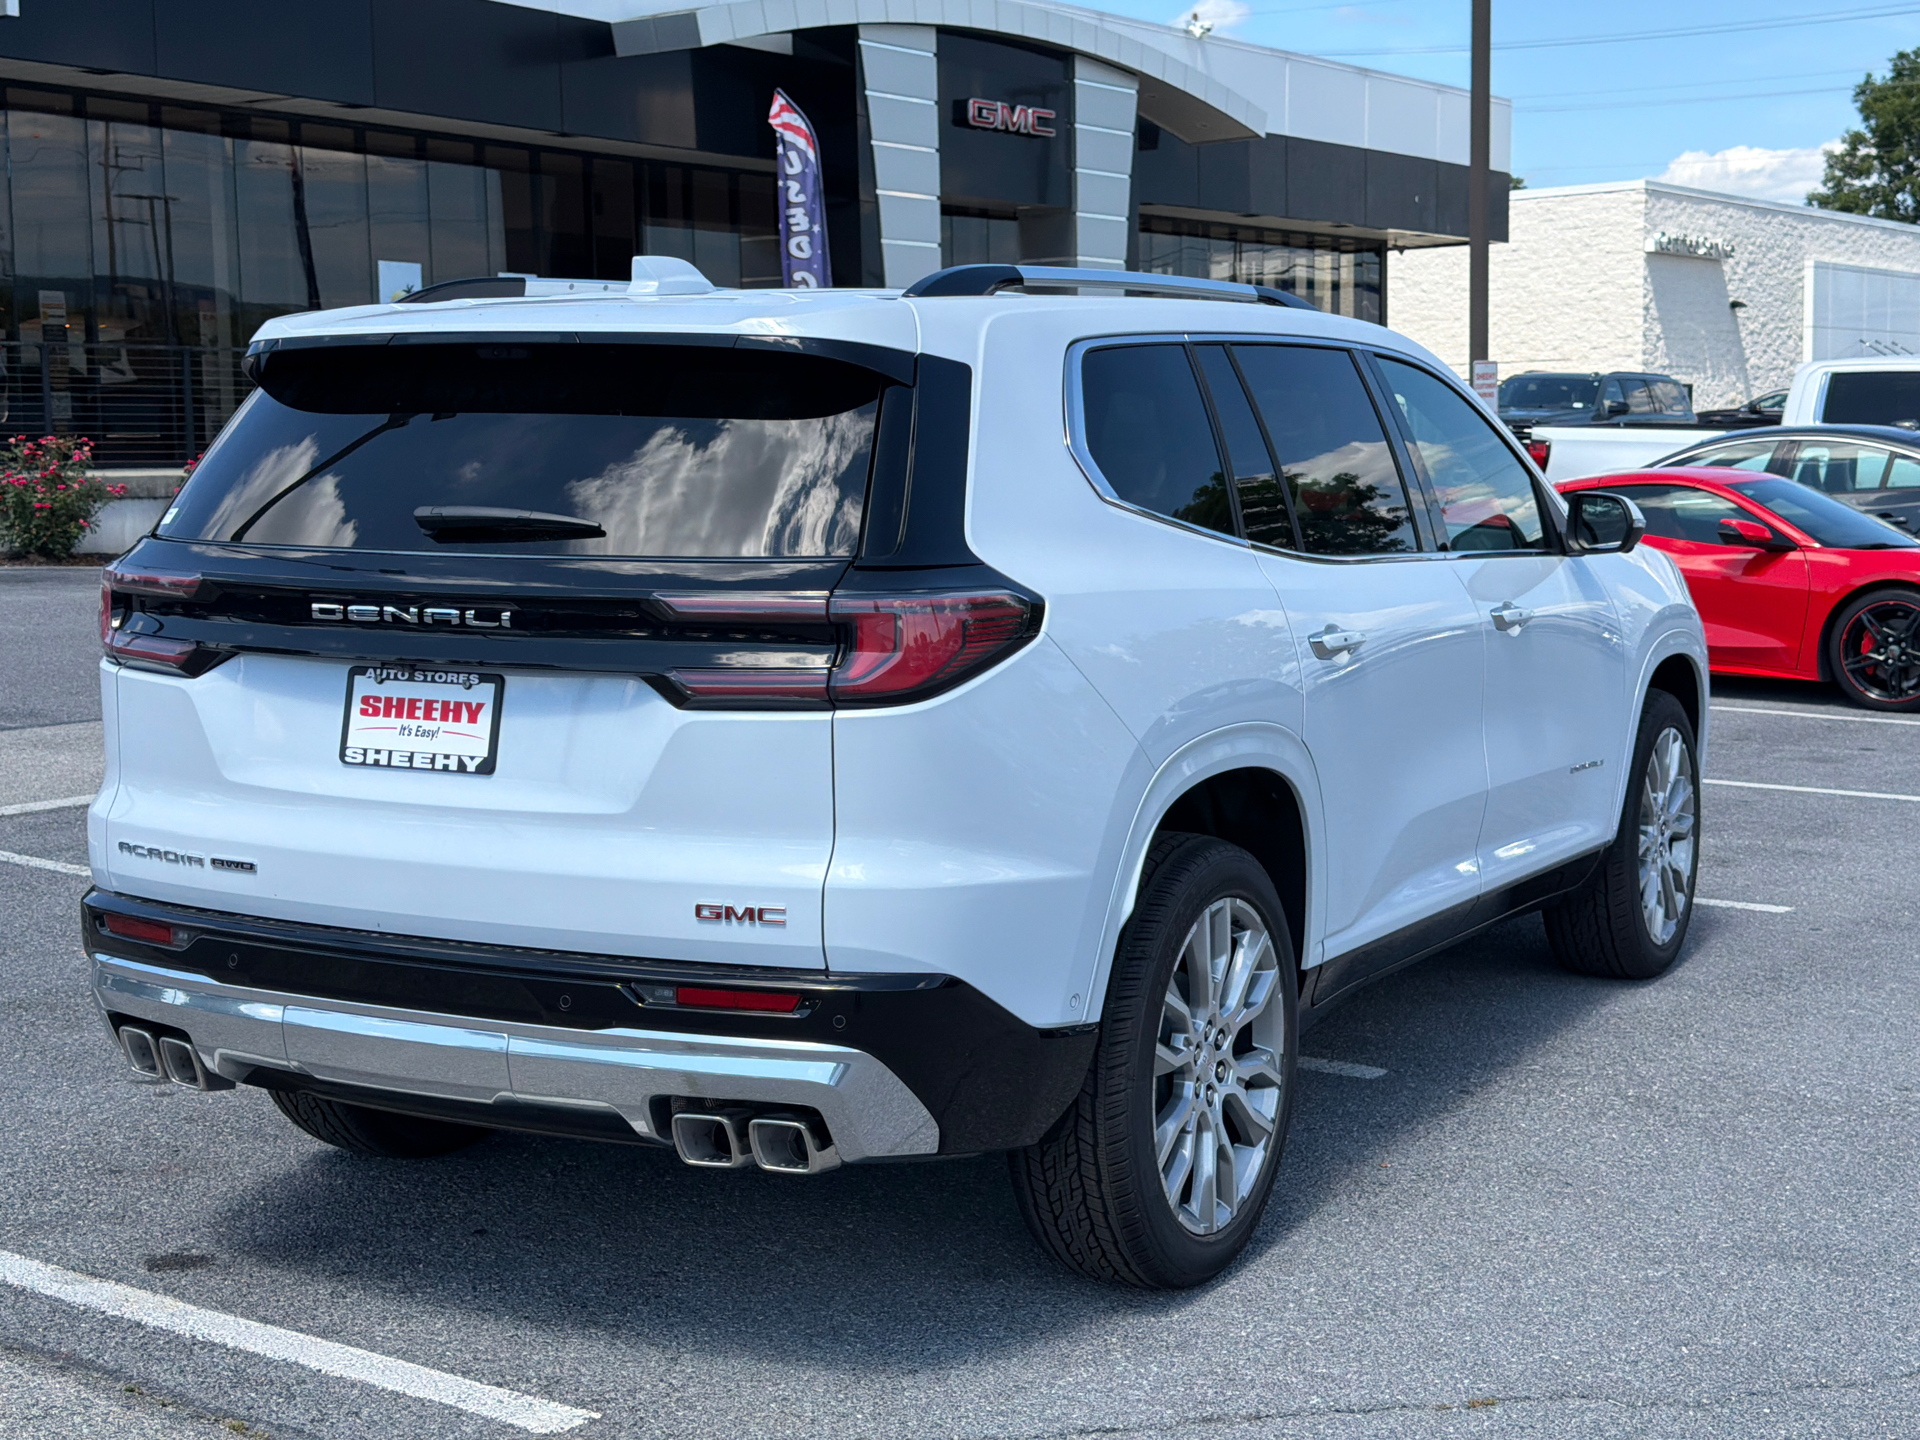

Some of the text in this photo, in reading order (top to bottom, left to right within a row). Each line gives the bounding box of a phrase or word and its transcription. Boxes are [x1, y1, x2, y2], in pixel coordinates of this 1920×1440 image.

[968, 98, 1056, 137] GMC
[311, 603, 511, 628] DENALI
[366, 668, 479, 685] AUTO STORES
[359, 694, 486, 725] SHEEHY
[398, 724, 440, 741] It's Easy!
[344, 747, 485, 773] SHEEHY
[117, 840, 257, 873] ACADIA AWD
[695, 902, 786, 925] GMC
